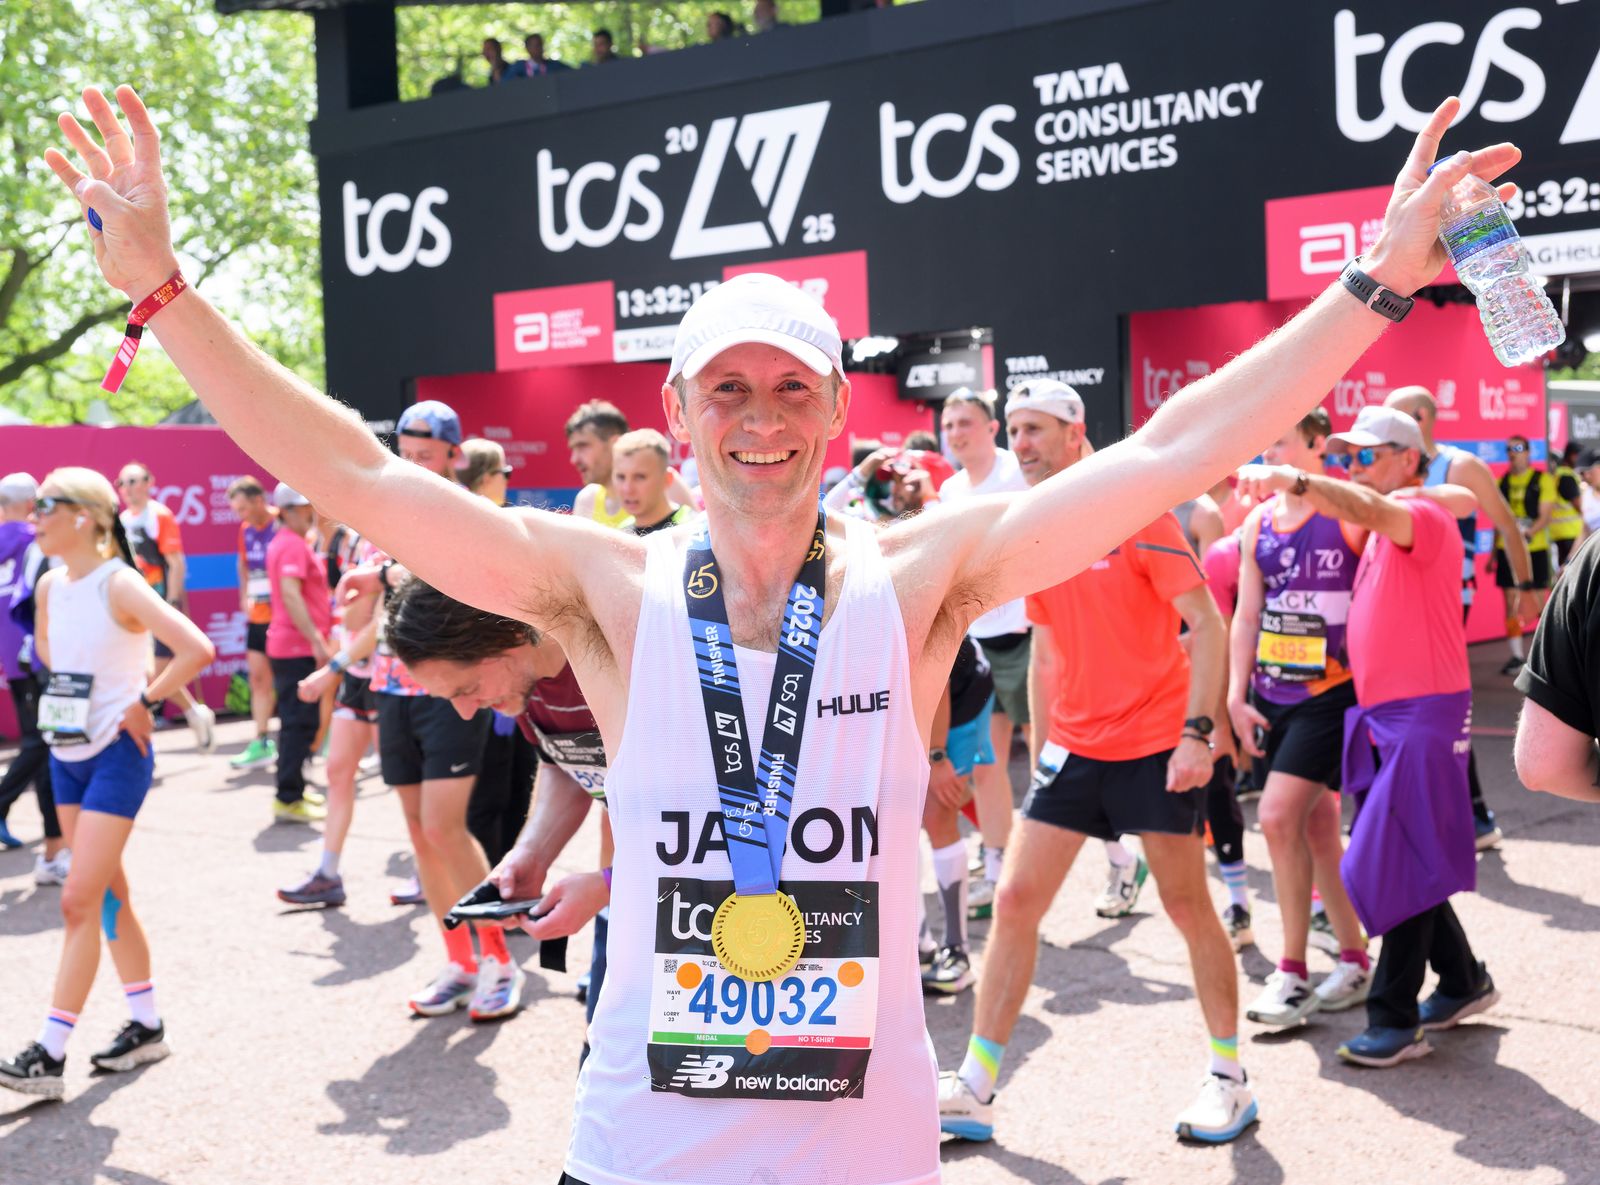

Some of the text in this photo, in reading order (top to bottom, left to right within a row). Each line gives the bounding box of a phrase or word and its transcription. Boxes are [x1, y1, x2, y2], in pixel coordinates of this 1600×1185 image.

[1033, 62, 1129, 106] TATA
[1334, 7, 1546, 142] tcs
[1035, 79, 1264, 144] CONSULTANCY
[665, 125, 698, 156] 20
[880, 101, 1020, 205] tcs
[1036, 133, 1179, 186] SERVICES
[536, 148, 663, 252] tcs
[342, 180, 452, 277] tcs
[803, 213, 836, 244] 25
[152, 282, 174, 302] SUITE
[1006, 355, 1049, 372] TATA
[1314, 548, 1344, 571] 70
[787, 585, 817, 647] 2025
[704, 625, 726, 686] FINISHER
[781, 673, 804, 702] tcs
[724, 742, 743, 774] tcs
[763, 753, 785, 817] FINISHER
[655, 807, 879, 866] JAON
[671, 891, 715, 942] tc
[688, 974, 838, 1027] 49032
[810, 1036, 834, 1044] T-SHIRT
[735, 1074, 850, 1093] new balance
